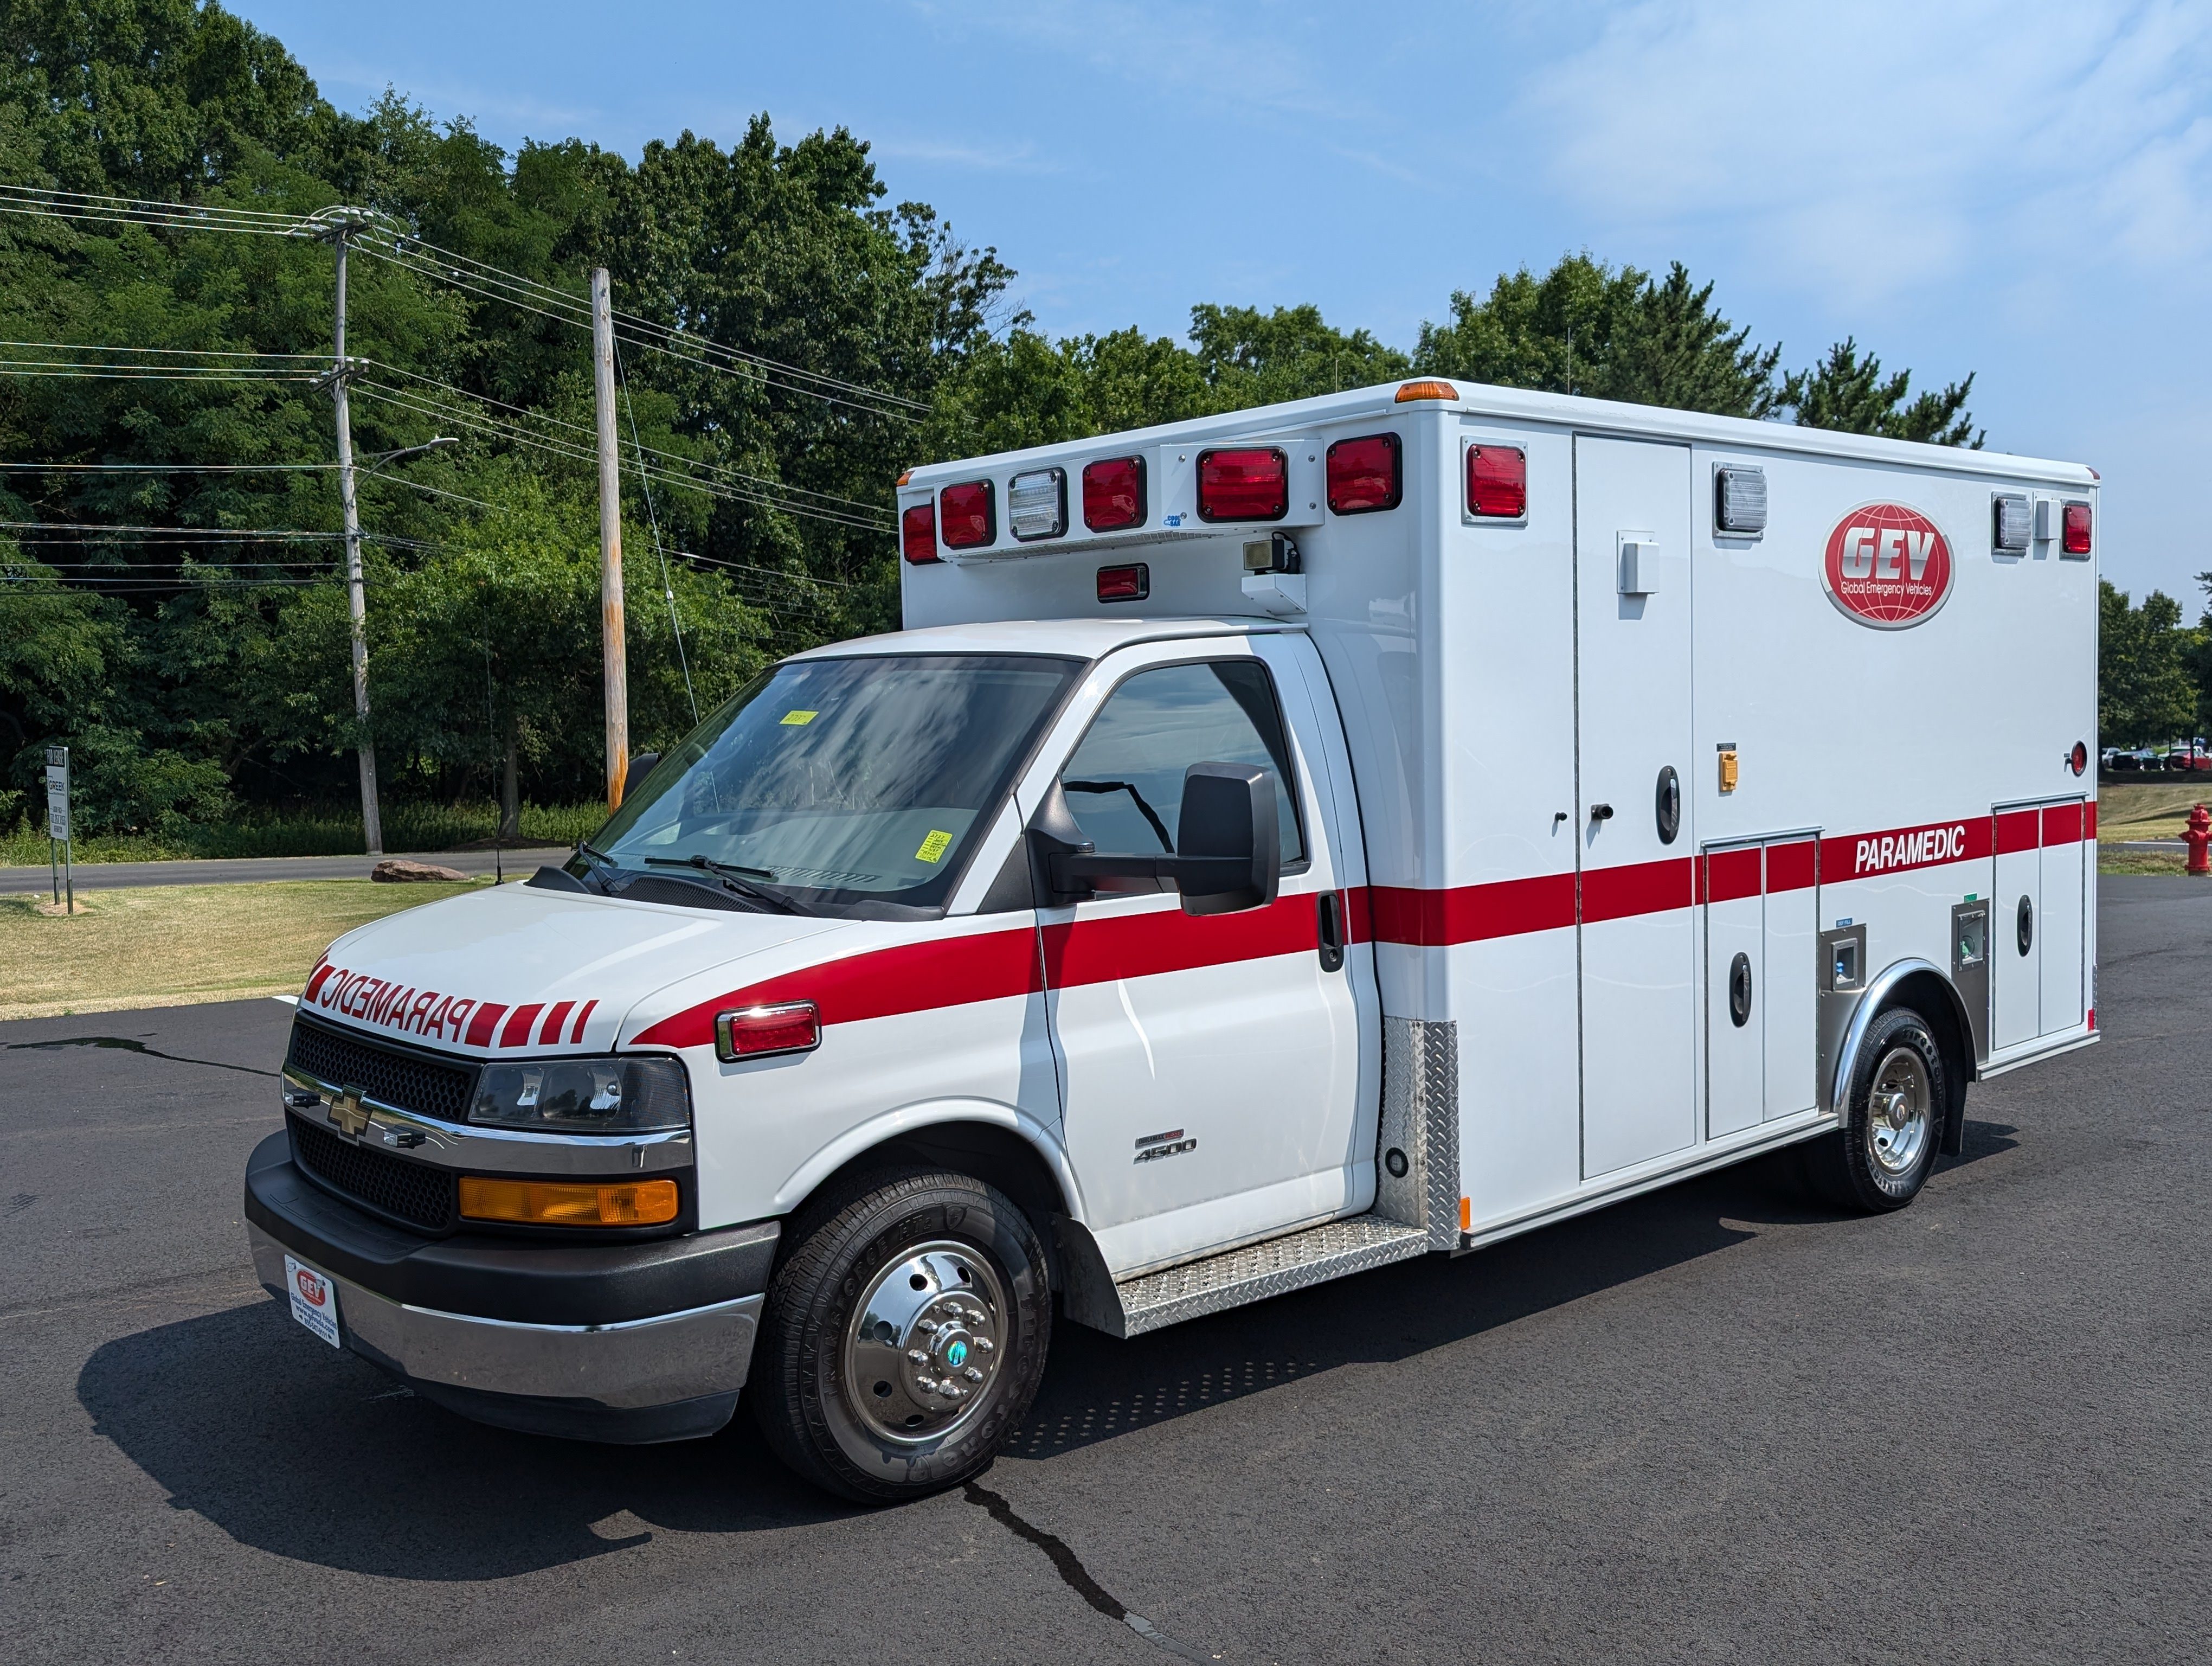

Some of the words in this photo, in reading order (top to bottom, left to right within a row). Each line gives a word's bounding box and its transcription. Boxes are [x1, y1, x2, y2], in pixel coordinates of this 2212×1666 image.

[1842, 527, 1934, 580] GEV
[1841, 581, 1865, 594] Global
[1867, 581, 1904, 597] Emergency
[1906, 583, 1932, 595] Vehicles
[1855, 825, 1965, 873] PARAMEDIC
[1139, 1135, 1165, 1144] DURAMAX
[1165, 1131, 1182, 1139] DIESEL
[1134, 1138, 1197, 1164] 4500
[300, 1275, 321, 1298] GEV
[291, 1292, 301, 1304] Global
[301, 1299, 321, 1321] Emergency
[322, 1312, 337, 1330] Vehicles
[824, 1235, 888, 1405] TRANSFORCE
[898, 1215, 933, 1241] HT2
